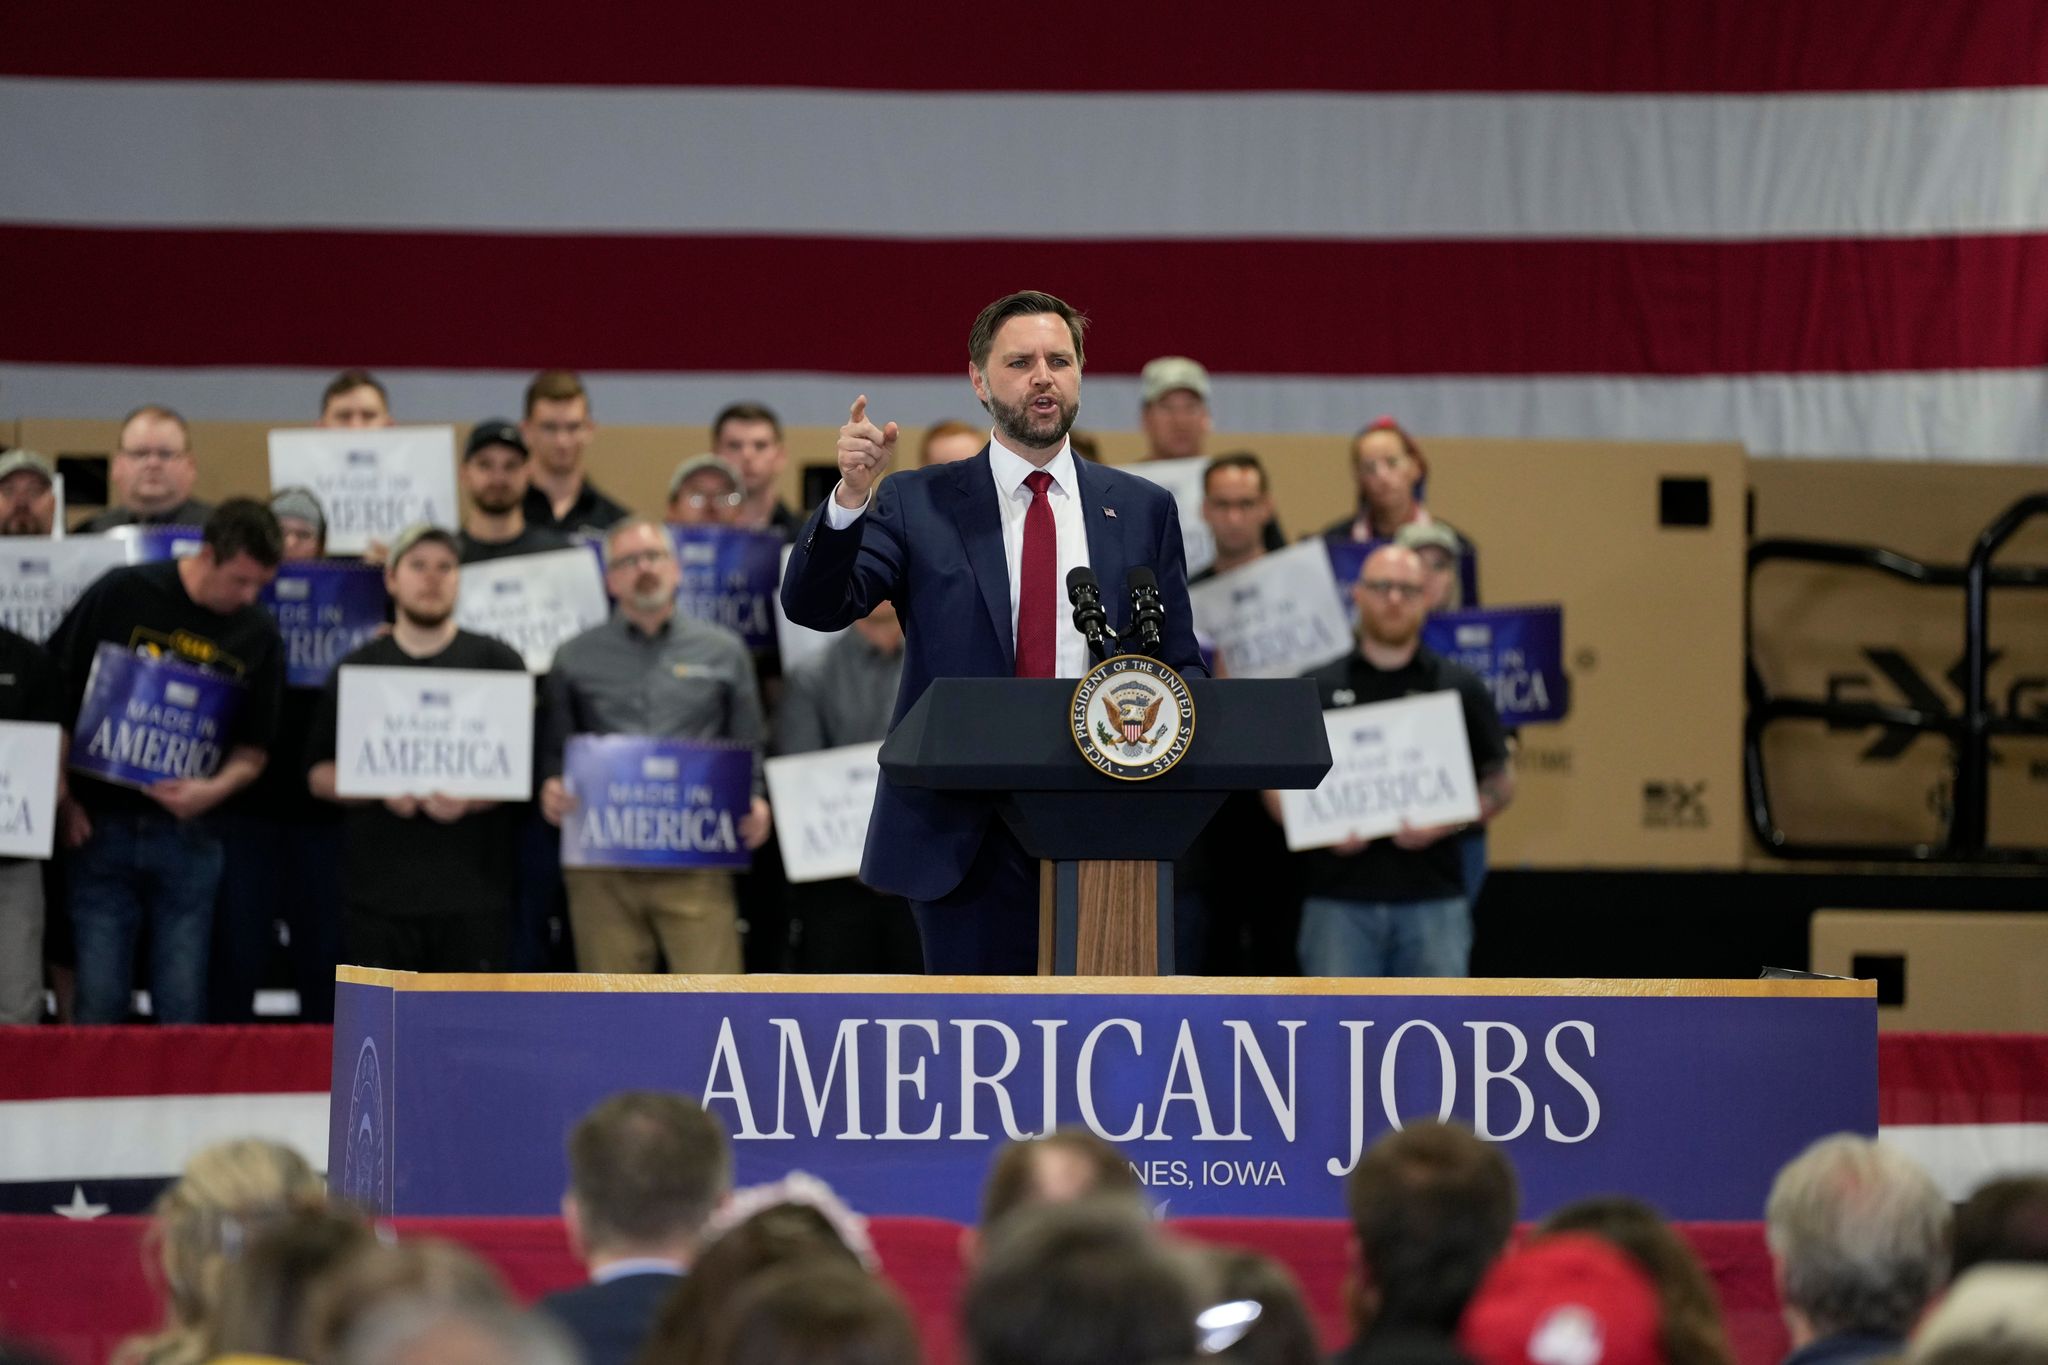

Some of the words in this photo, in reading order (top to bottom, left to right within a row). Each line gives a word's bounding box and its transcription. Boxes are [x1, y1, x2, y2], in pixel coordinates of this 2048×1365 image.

[1113, 660, 1128, 672] OF
[1132, 660, 1154, 673] THE
[1075, 666, 1109, 740] PRESIDENT
[1158, 667, 1192, 719] UNITED
[127, 698, 194, 734] MADE
[87, 716, 222, 780] AMERIC
[355, 736, 512, 779] AMERICA
[1083, 742, 1113, 773] VICE
[1152, 725, 1191, 773] STATES
[579, 805, 738, 854] AMERICA
[703, 1016, 1307, 1142] AMERICAN
[1326, 1018, 1600, 1177] JOBS
[1127, 1161, 1194, 1190] NES,
[1203, 1161, 1286, 1186] IOWA
